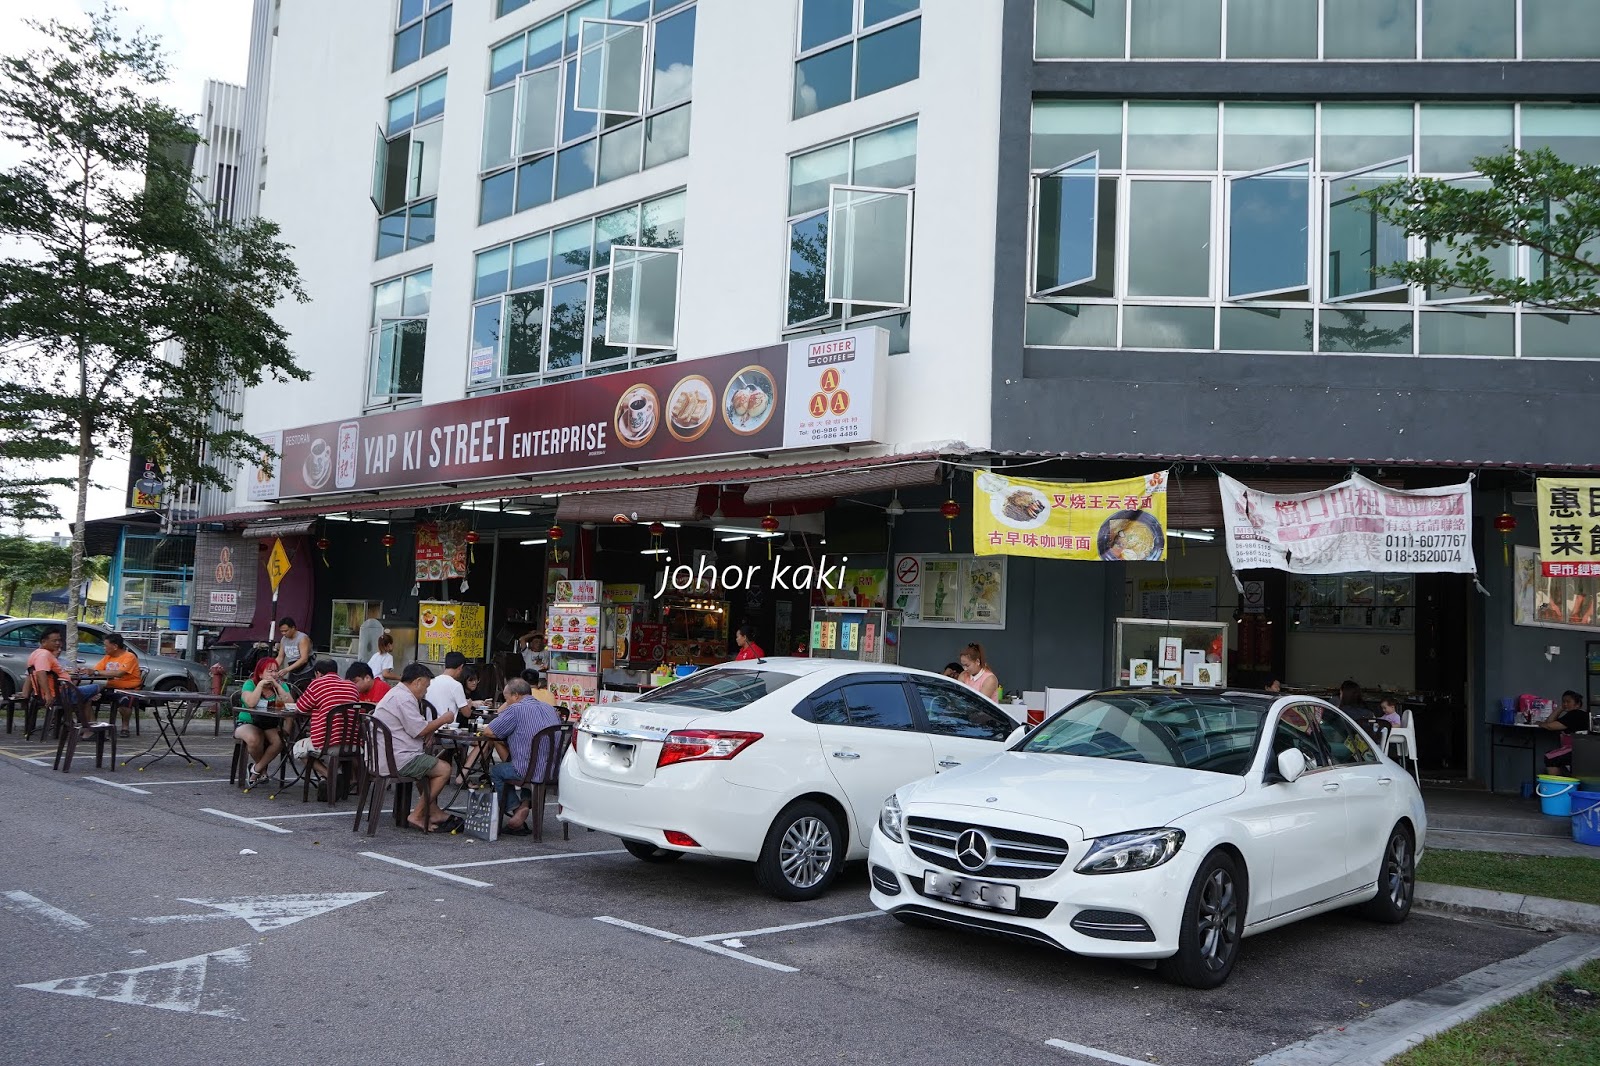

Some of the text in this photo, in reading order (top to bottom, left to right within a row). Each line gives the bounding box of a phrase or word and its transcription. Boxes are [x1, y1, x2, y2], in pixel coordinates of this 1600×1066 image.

[812, 340, 852, 356] MISTER
[816, 352, 846, 364] COFFEE
[824, 371, 836, 389] A
[813, 393, 846, 414] A A
[811, 426, 838, 435] 06-986
[840, 424, 858, 432] 5115
[811, 430, 858, 441] 06-986 4486
[364, 433, 397, 475] YAP
[402, 430, 423, 471] KI
[429, 416, 510, 468] STREET
[512, 421, 608, 459] ENTERPRISE
[988, 531, 1091, 550] 古早味咖喱面
[1385, 534, 1467, 548] 0111-6077767
[1385, 549, 1462, 562] 018-3520074
[212, 593, 235, 603] MISTER
[457, 620, 483, 630] LEMAK
